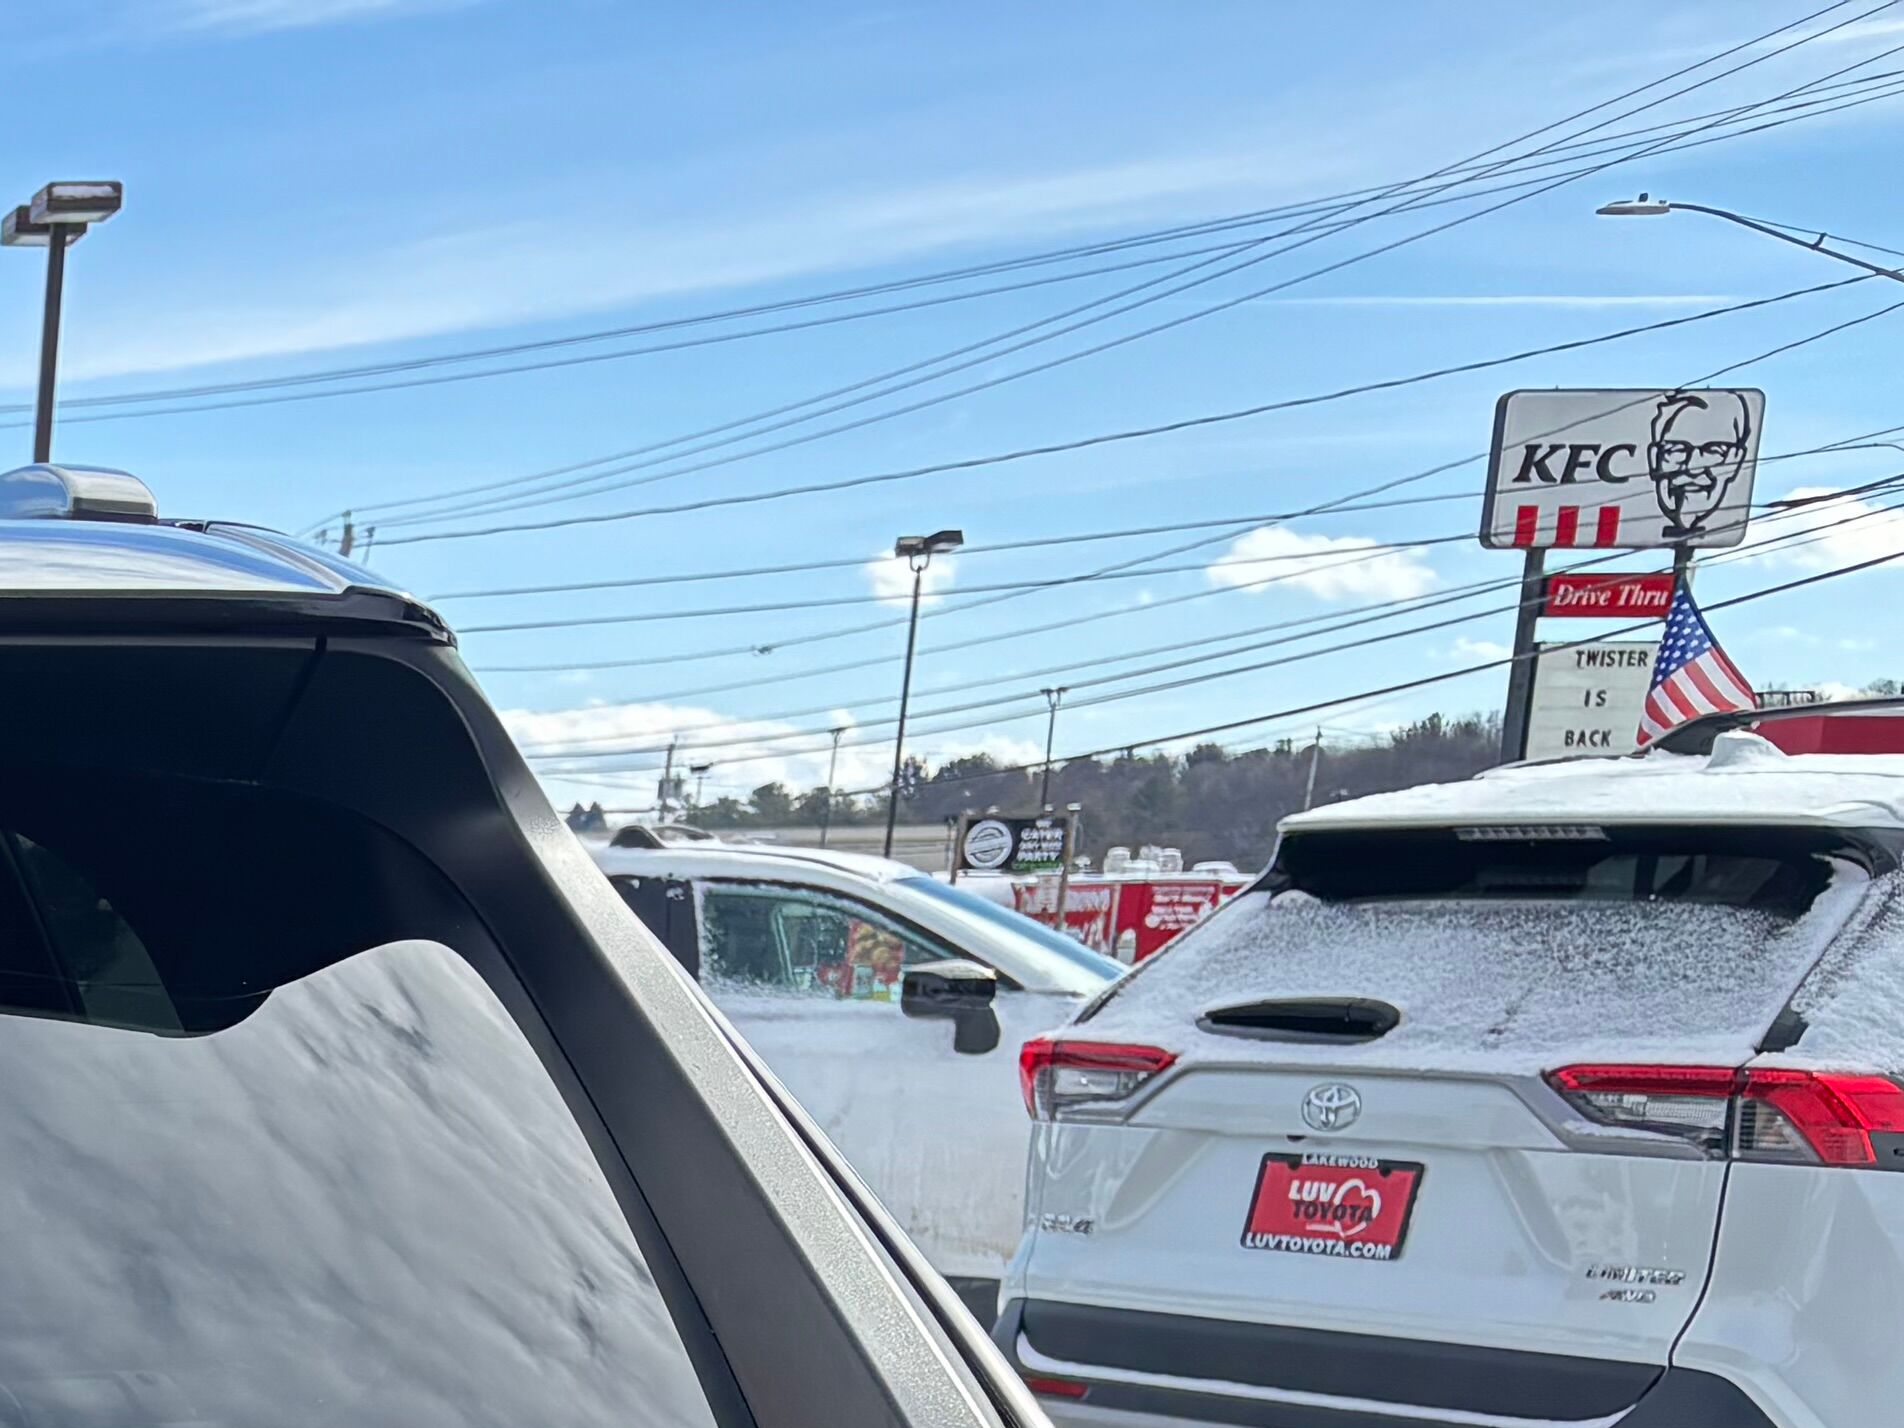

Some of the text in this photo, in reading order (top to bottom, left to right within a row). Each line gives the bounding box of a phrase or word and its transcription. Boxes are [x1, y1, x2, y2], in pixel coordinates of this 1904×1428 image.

[1512, 443, 1637, 484] KFC
[1553, 584, 1669, 608] Drive Thru
[1576, 650, 1649, 669] TWISTER
[1585, 690, 1607, 707] IS
[1564, 729, 1612, 748] BACK
[1302, 1154, 1379, 1169] LAKEWOOD
[1288, 1180, 1337, 1202] LUV
[1293, 1201, 1374, 1223] TOYOTA
[1245, 1231, 1392, 1259] LUVTOYOTA.COM
